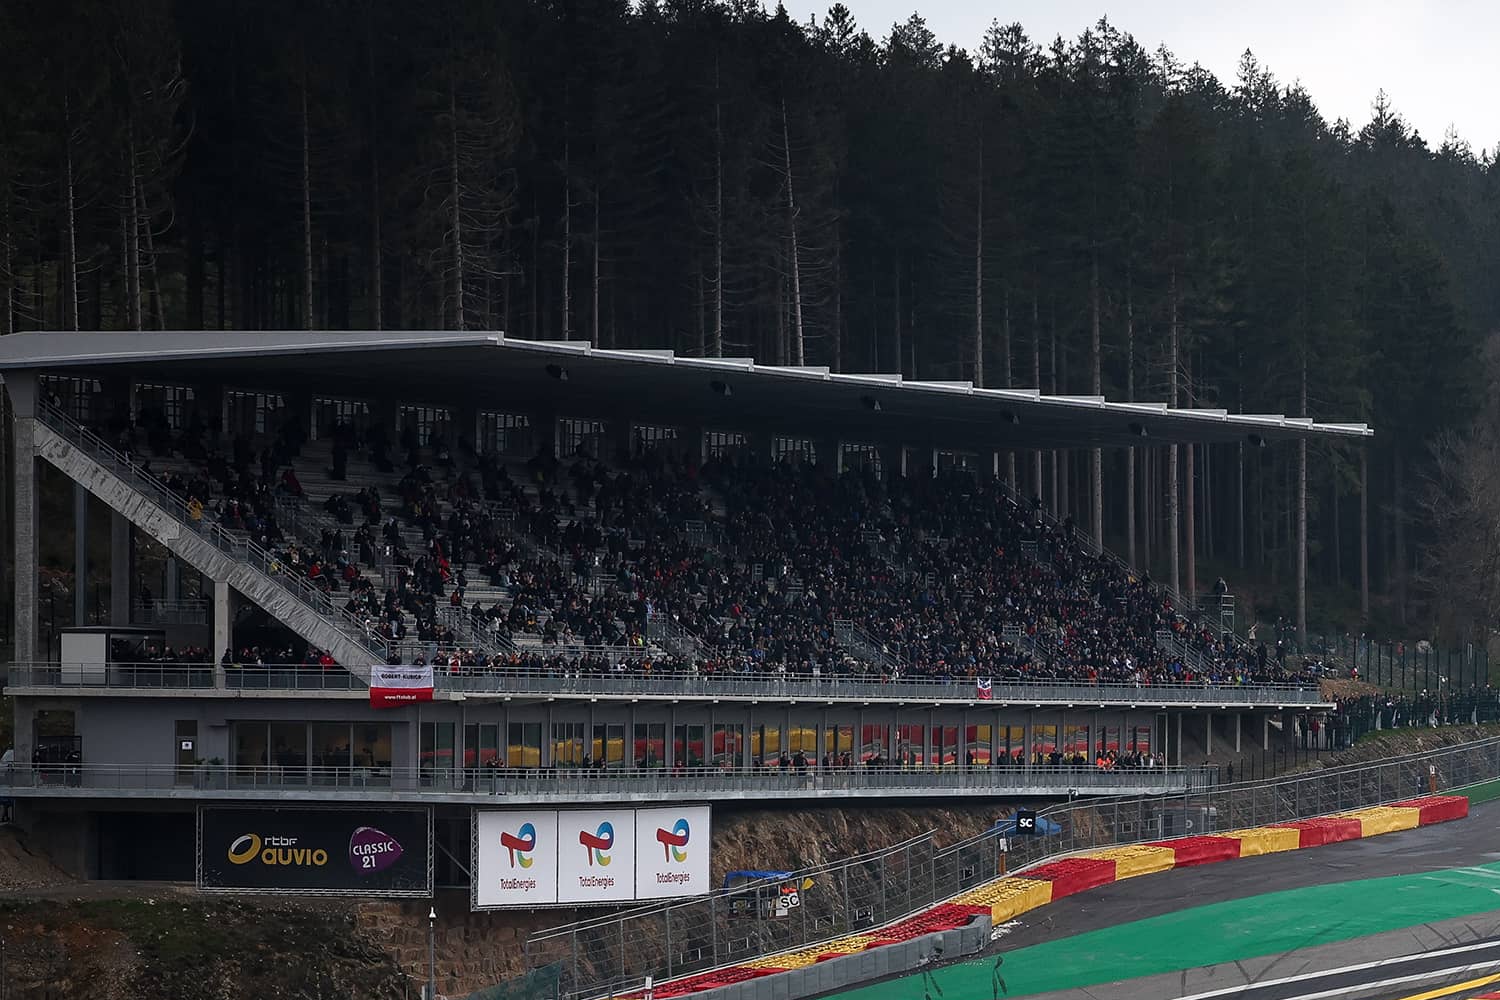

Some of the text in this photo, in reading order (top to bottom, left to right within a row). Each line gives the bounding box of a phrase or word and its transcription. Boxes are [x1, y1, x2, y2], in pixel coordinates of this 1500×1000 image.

[1019, 817, 1033, 828] SC
[264, 835, 298, 847] rtbf
[352, 841, 394, 856] CLASSIC
[261, 848, 328, 866] auvio
[362, 855, 376, 869] 21
[500, 878, 537, 892] TotalEnergies
[579, 875, 615, 890] TotalEnergies
[656, 871, 691, 887] TotalEnergies
[780, 895, 799, 908] SC
